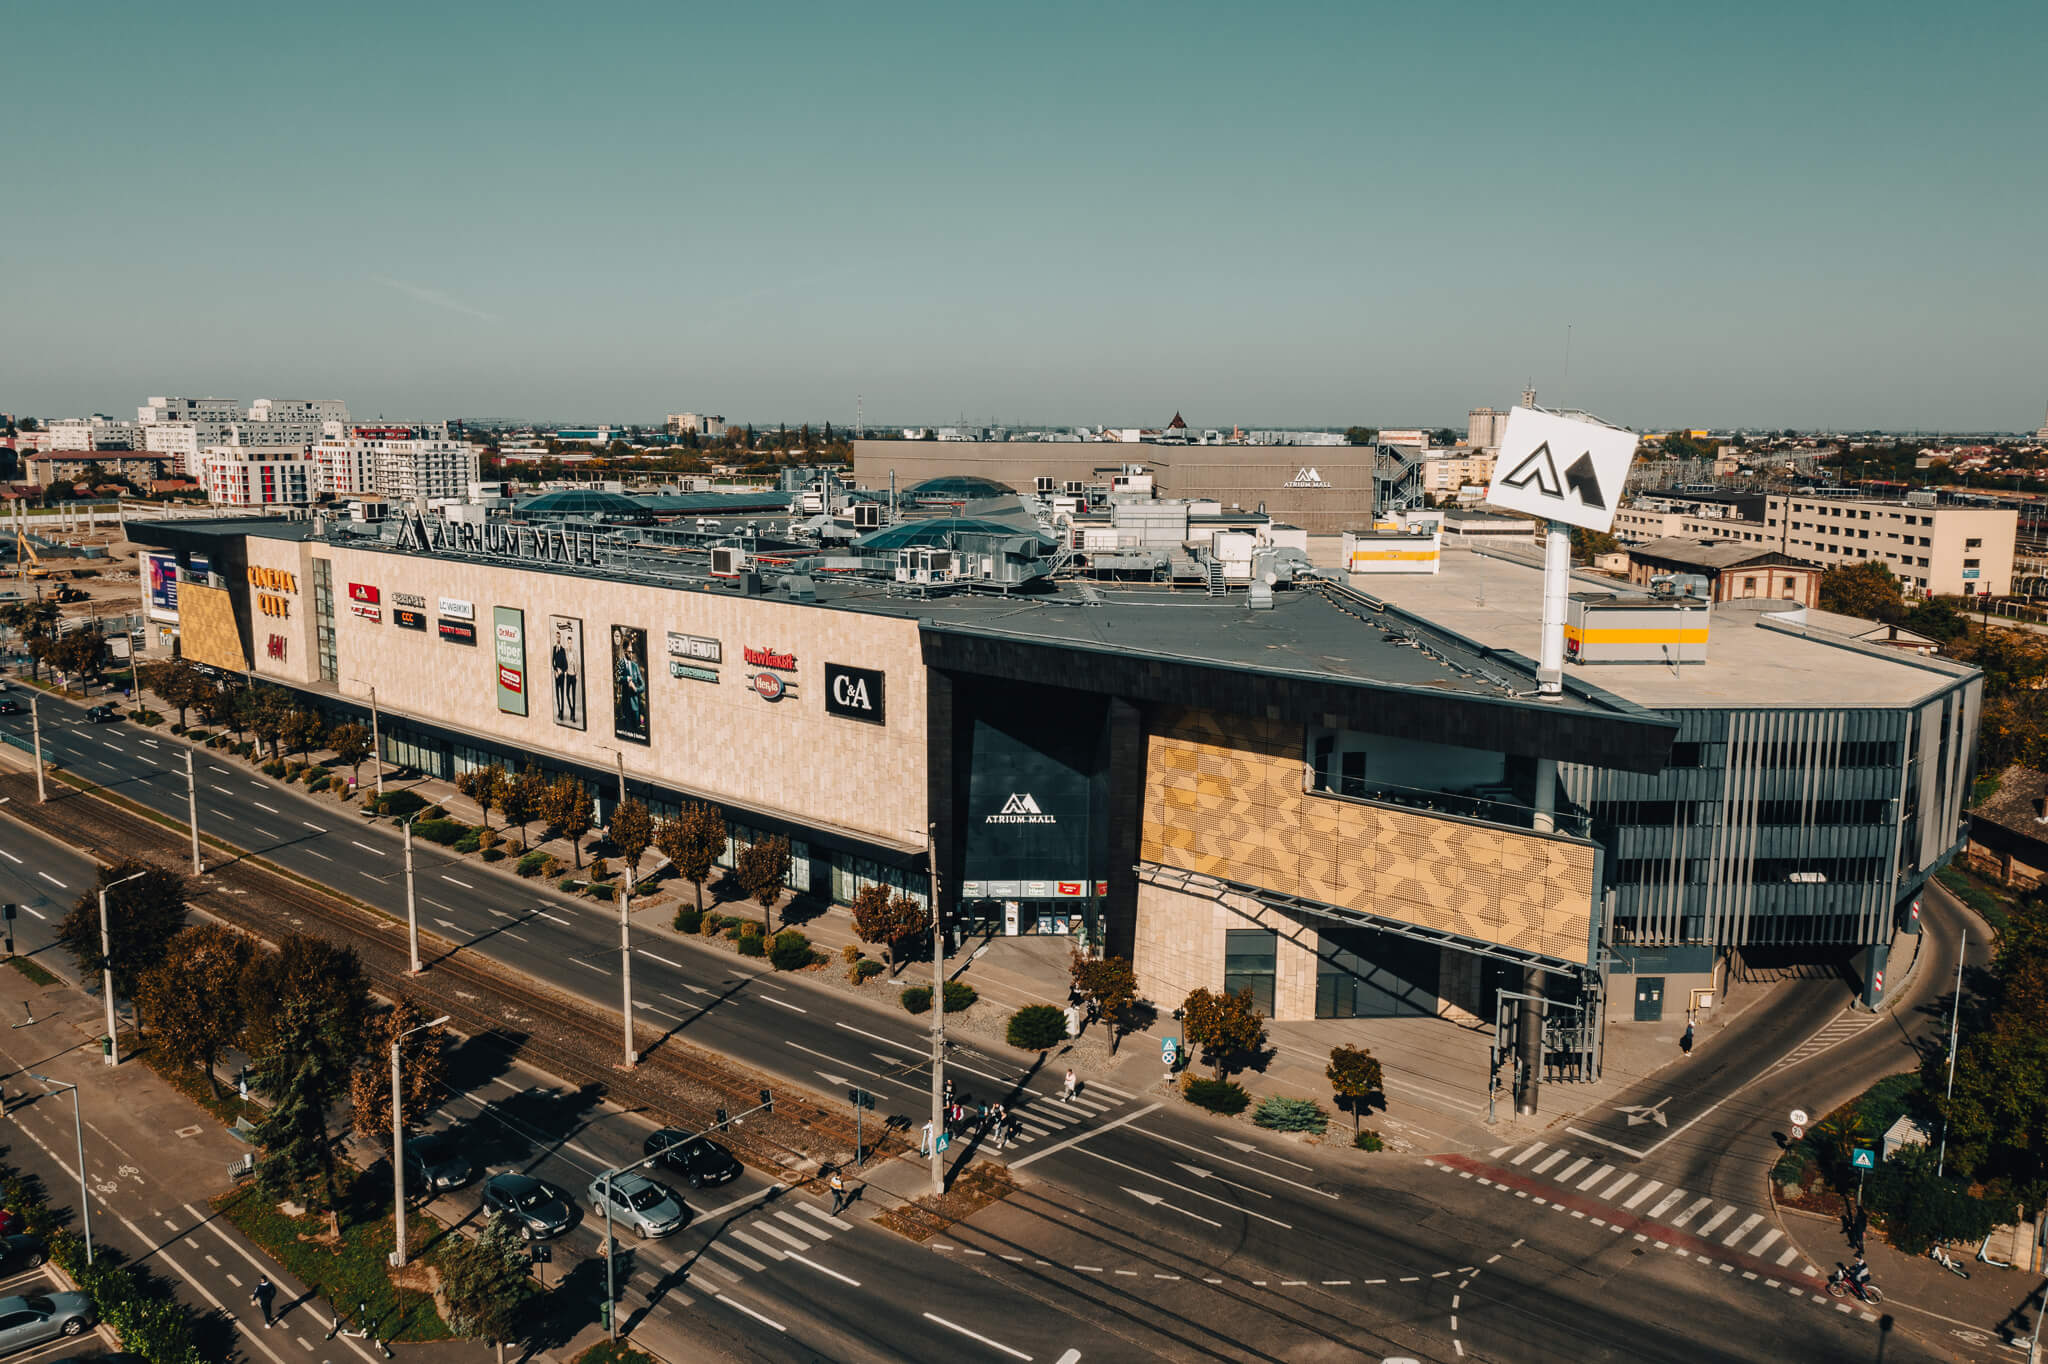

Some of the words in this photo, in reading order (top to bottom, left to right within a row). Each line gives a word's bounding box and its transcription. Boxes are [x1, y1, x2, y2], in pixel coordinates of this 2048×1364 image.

[434, 518, 522, 557] ATRIUM
[533, 527, 604, 568] MALL
[247, 567, 296, 593] CINEMA
[257, 591, 287, 617] CITY
[401, 612, 414, 622] CCC
[496, 640, 521, 657] Hiper
[666, 637, 720, 659] BENVENUTI
[756, 677, 778, 693] Hervis
[833, 674, 872, 710] C&A
[985, 815, 1025, 824] ATRIUM
[1028, 815, 1057, 824] MALL
